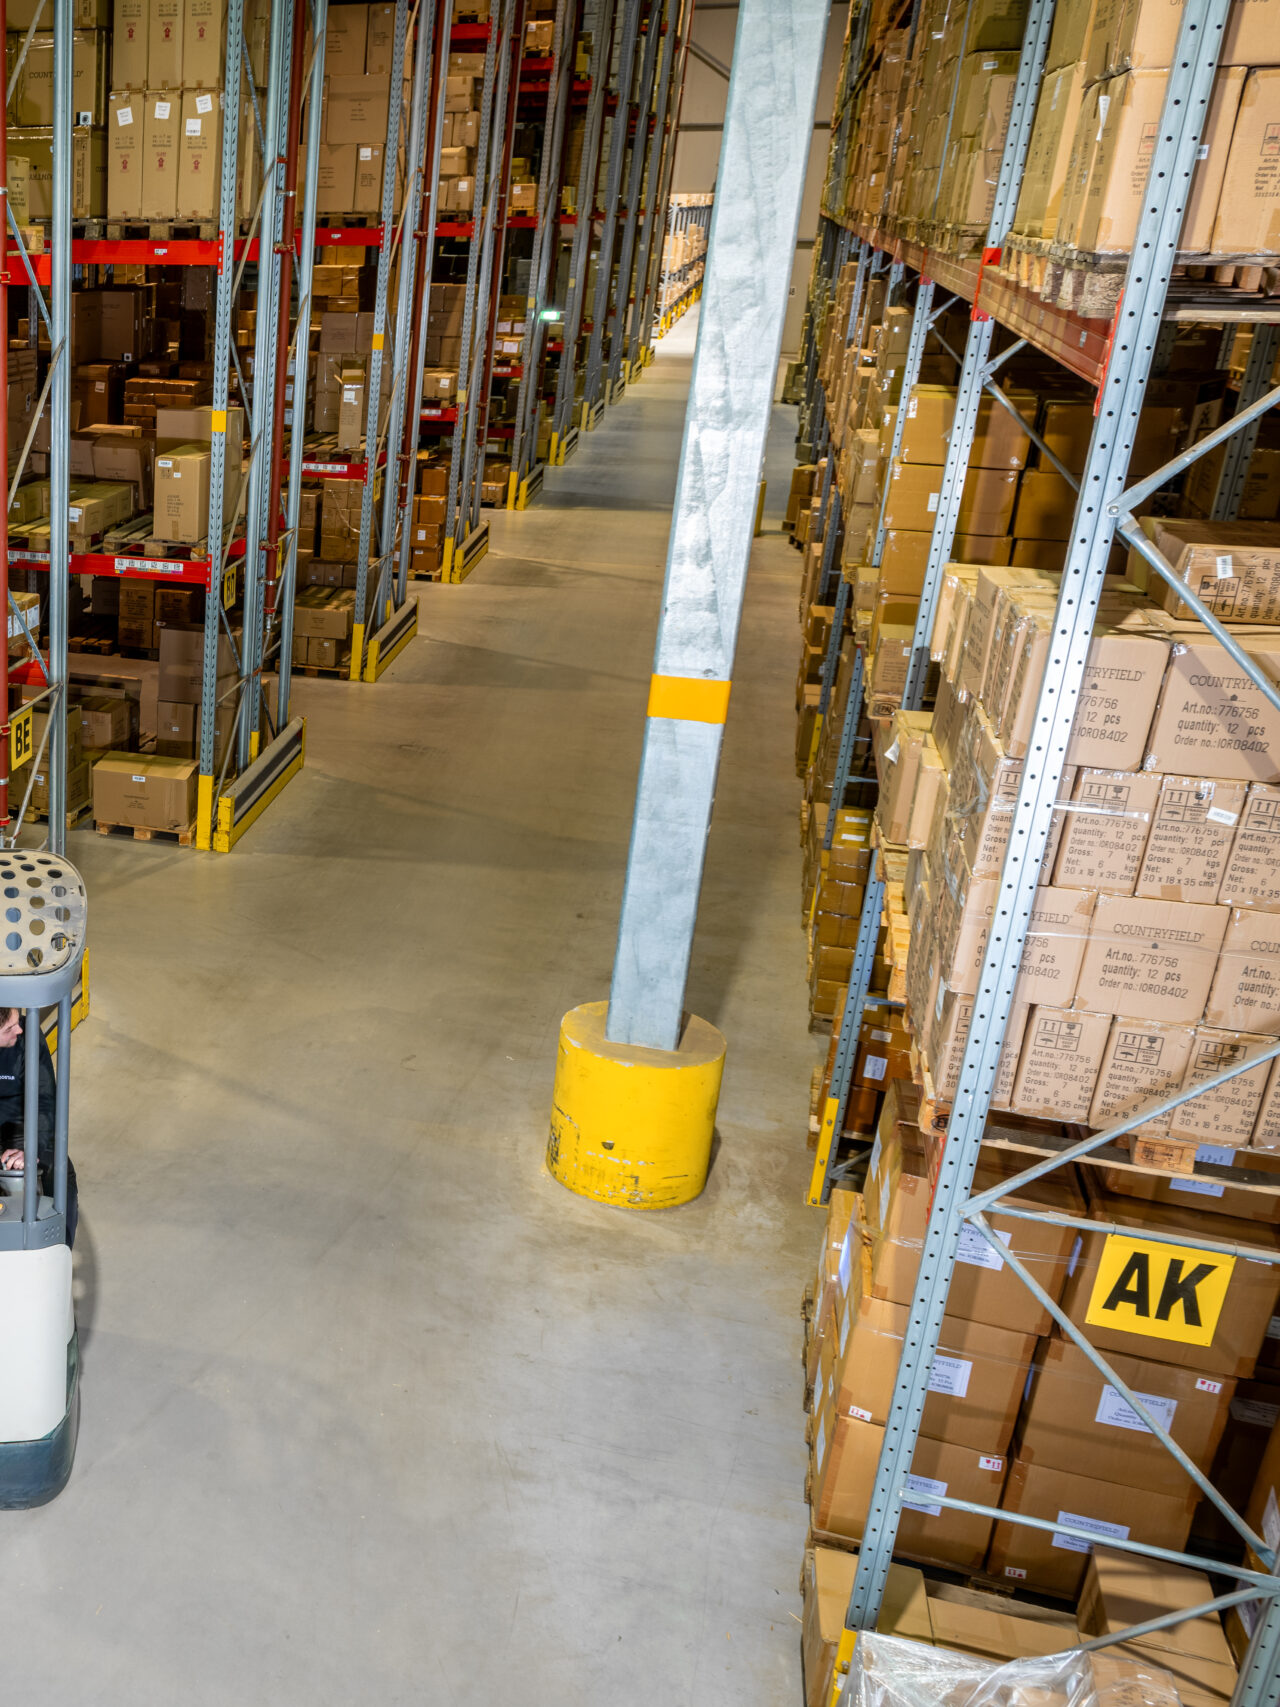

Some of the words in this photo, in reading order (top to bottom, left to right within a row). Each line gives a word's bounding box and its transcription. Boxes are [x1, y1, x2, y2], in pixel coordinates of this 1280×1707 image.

[29, 69, 83, 79] COUNTLD
[1085, 666, 1145, 682] TRYFIELD
[1189, 674, 1265, 692] COUNTRYF
[1086, 712, 1097, 723] 12
[1104, 714, 1121, 726] pcs
[1177, 719, 1219, 734] quantity:
[1227, 723, 1238, 735] 12
[1247, 725, 1266, 738] pcs
[15, 716, 30, 760] BE
[1174, 734, 1198, 747] Order
[990, 813, 1012, 824] quant
[984, 834, 1007, 844] Gross
[1131, 833, 1146, 843] pcs
[1240, 832, 1280, 845] Art.no.:77
[1068, 847, 1094, 857] Gross:
[1065, 858, 1081, 867] Net:
[1124, 864, 1138, 874] kgs
[1147, 853, 1174, 864] Gross:
[1206, 860, 1220, 870] kgs
[1064, 867, 1076, 875] 30
[1105, 870, 1117, 880] 35
[1119, 874, 1135, 882] cms
[1145, 864, 1161, 873] Net:
[1203, 870, 1217, 879] kgs
[1231, 864, 1258, 875] Gross:
[1142, 874, 1155, 883] 30
[1165, 876, 1174, 885] 18
[1183, 878, 1196, 887] 35
[1228, 874, 1245, 884] Net:
[1225, 884, 1238, 893] 30
[1249, 886, 1259, 896] 18
[1031, 911, 1070, 924] YFIELD
[1113, 923, 1204, 943] COUNTRYFIELD
[1039, 953, 1056, 964] pcs
[1102, 963, 1140, 979] quantity:
[1147, 969, 1158, 979] 12
[1164, 971, 1182, 983] pcs
[1098, 977, 1121, 990] Order
[1234, 995, 1258, 1008] Order
[1025, 1077, 1049, 1087] Gross:
[1165, 1081, 1179, 1089] pcs
[1103, 1091, 1128, 1101] Gross:
[1247, 1089, 1262, 1098] pcs
[1101, 1101, 1117, 1109] Net:
[1179, 1118, 1191, 1126] 30
[1222, 1122, 1233, 1132] 35
[1102, 1252, 1219, 1327] AK
